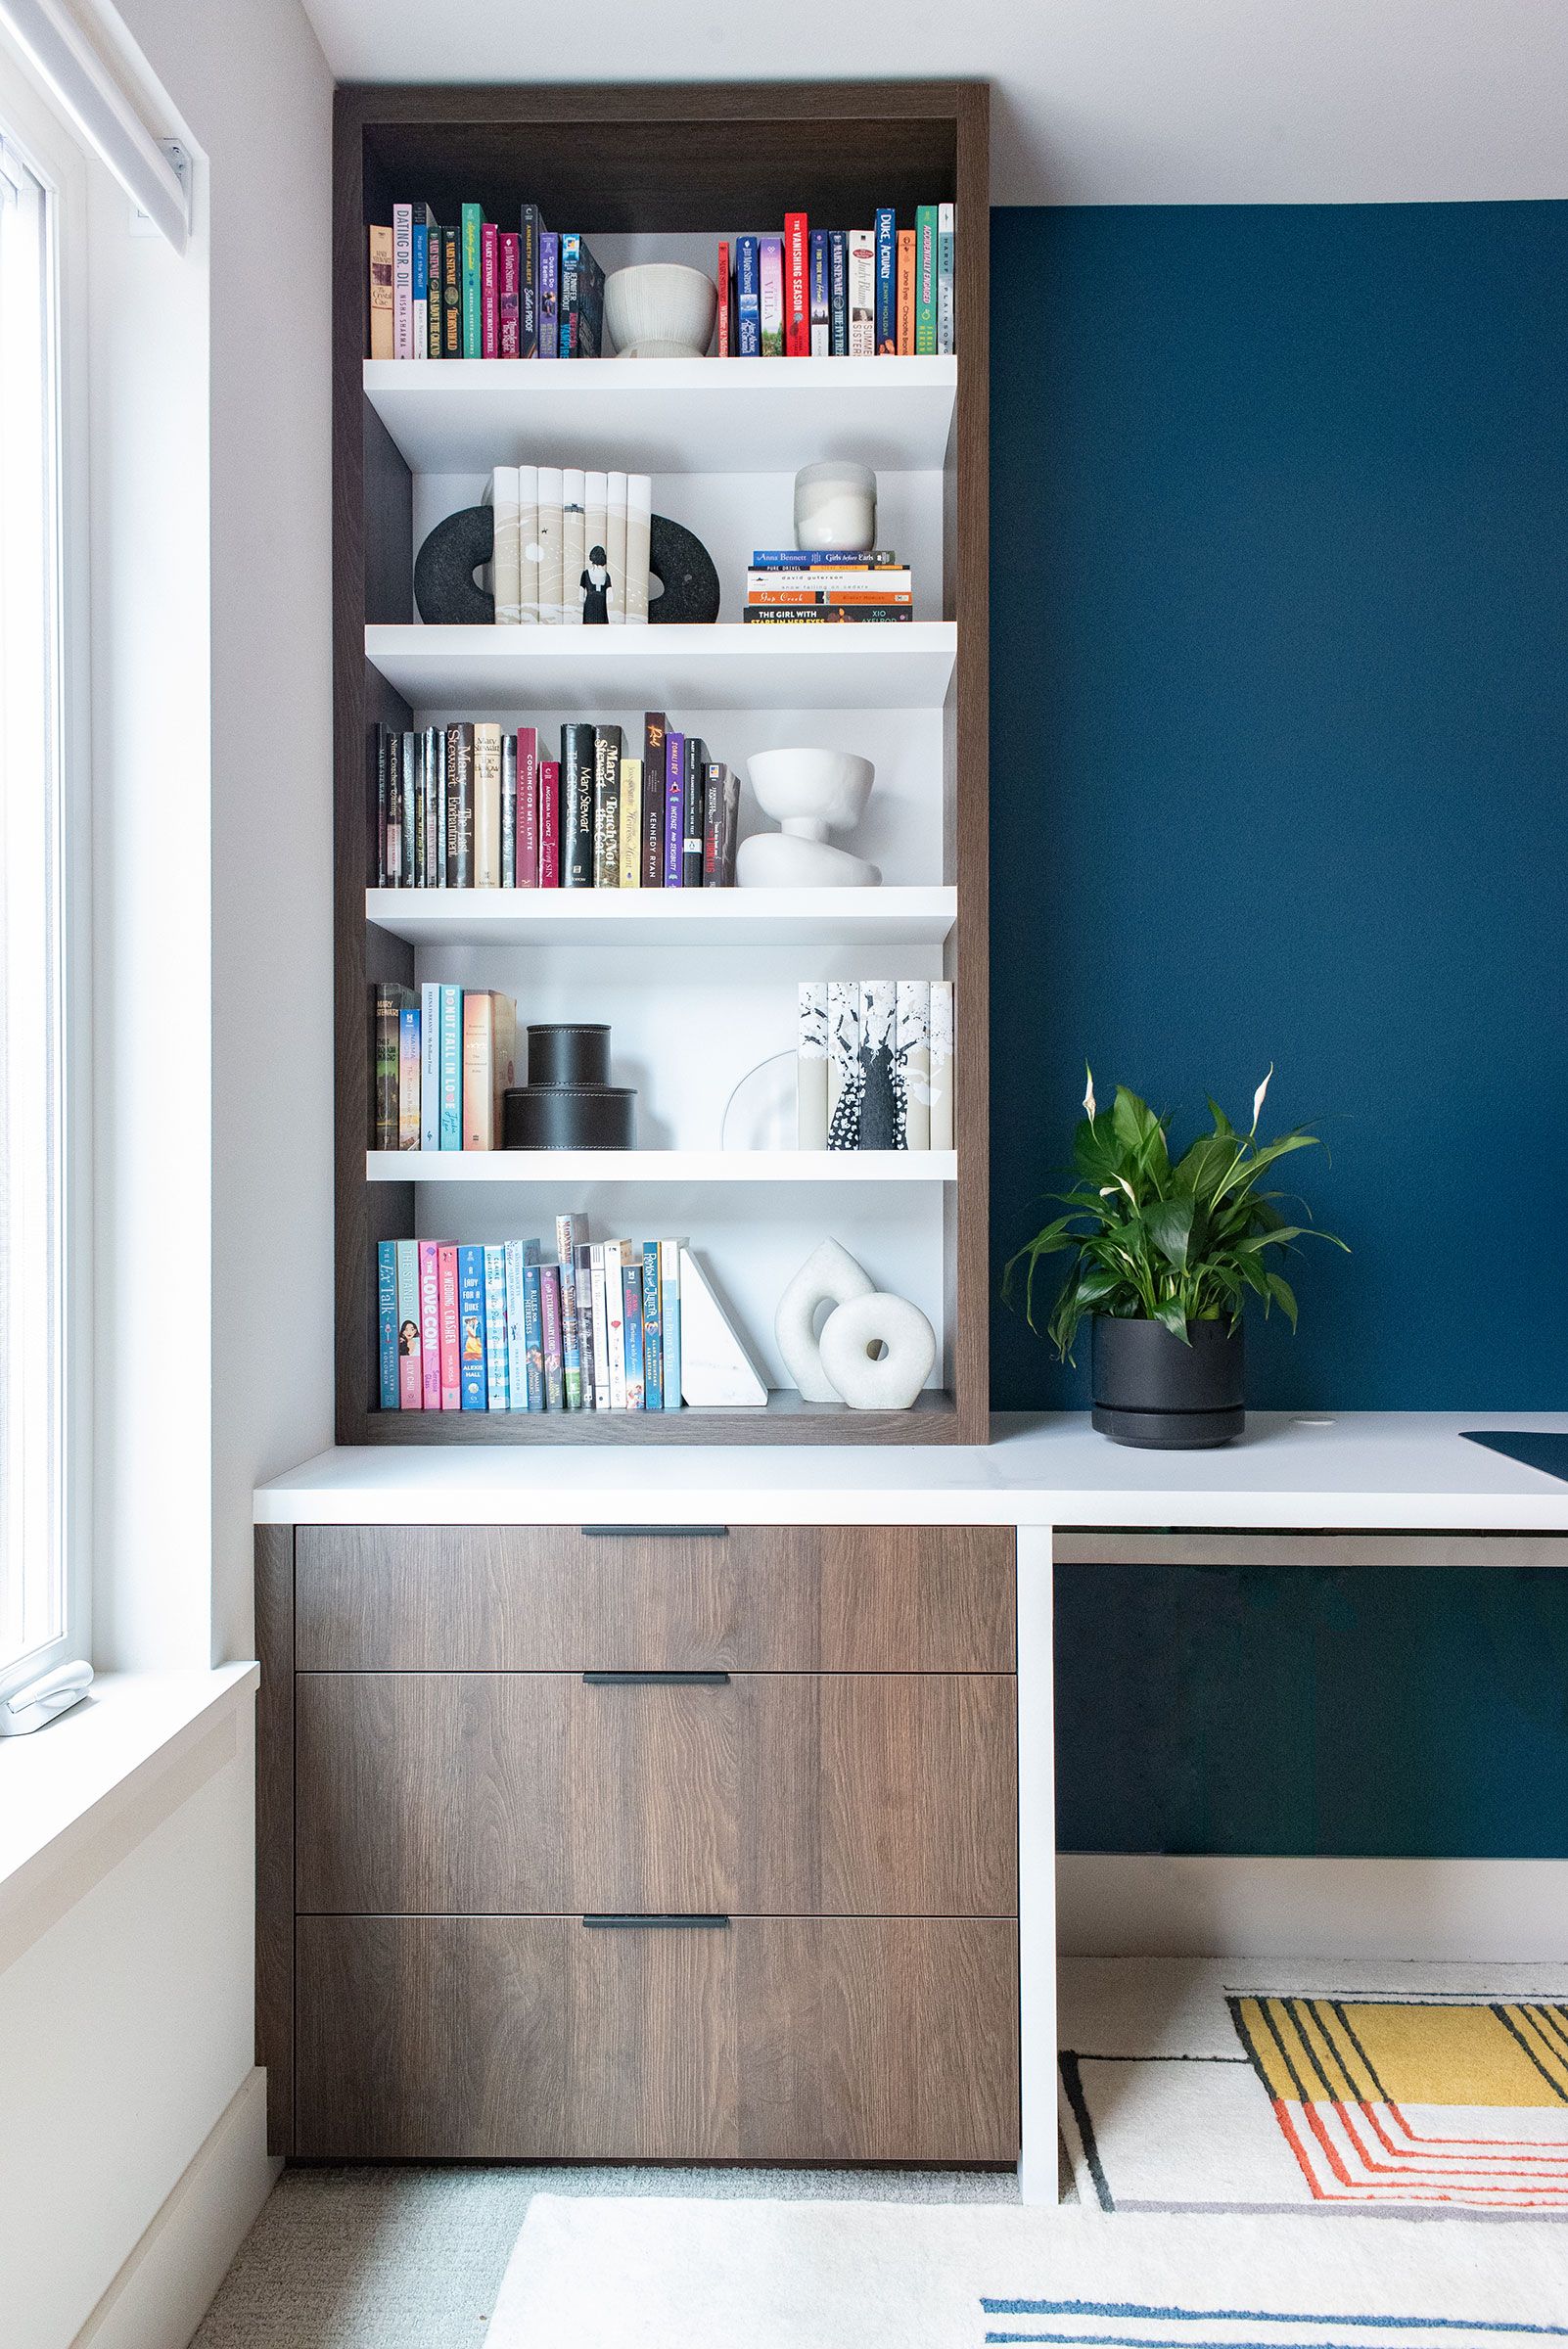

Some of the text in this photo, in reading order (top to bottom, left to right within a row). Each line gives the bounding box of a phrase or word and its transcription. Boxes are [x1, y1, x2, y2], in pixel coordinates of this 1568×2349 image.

[881, 214, 891, 242] DUKE,
[397, 210, 409, 289] DATING DR. DIL
[447, 242, 455, 284] MARY STEWART
[793, 232, 802, 276] VANISHING
[549, 279, 555, 288] Do
[834, 245, 842, 296] MARY STEWART
[765, 281, 773, 321] VILLA
[793, 279, 802, 310] SEASON
[859, 280, 871, 306] Blume
[835, 311, 843, 337] THE IVY
[780, 593, 803, 601] Creek
[448, 730, 460, 788] Stewart
[456, 745, 471, 785] Mary
[594, 739, 607, 788] Stewart
[604, 745, 618, 784] Mary
[578, 767, 591, 833] Mary Stewart
[448, 797, 461, 857] Enchantment
[458, 808, 471, 854] The Last
[604, 797, 618, 866] Touch Not
[445, 989, 456, 1027] DONUT
[445, 1033, 456, 1058] FALL
[445, 1063, 456, 1073] IN
[381, 1264, 394, 1283] Ex
[403, 1249, 413, 1317] THE STAND-IN
[381, 1285, 394, 1314] Talk
[444, 1277, 455, 1344] WEDDING CRASHER
[547, 1294, 556, 1336] EXTRAORDINARY
[423, 1316, 437, 1350] CON
